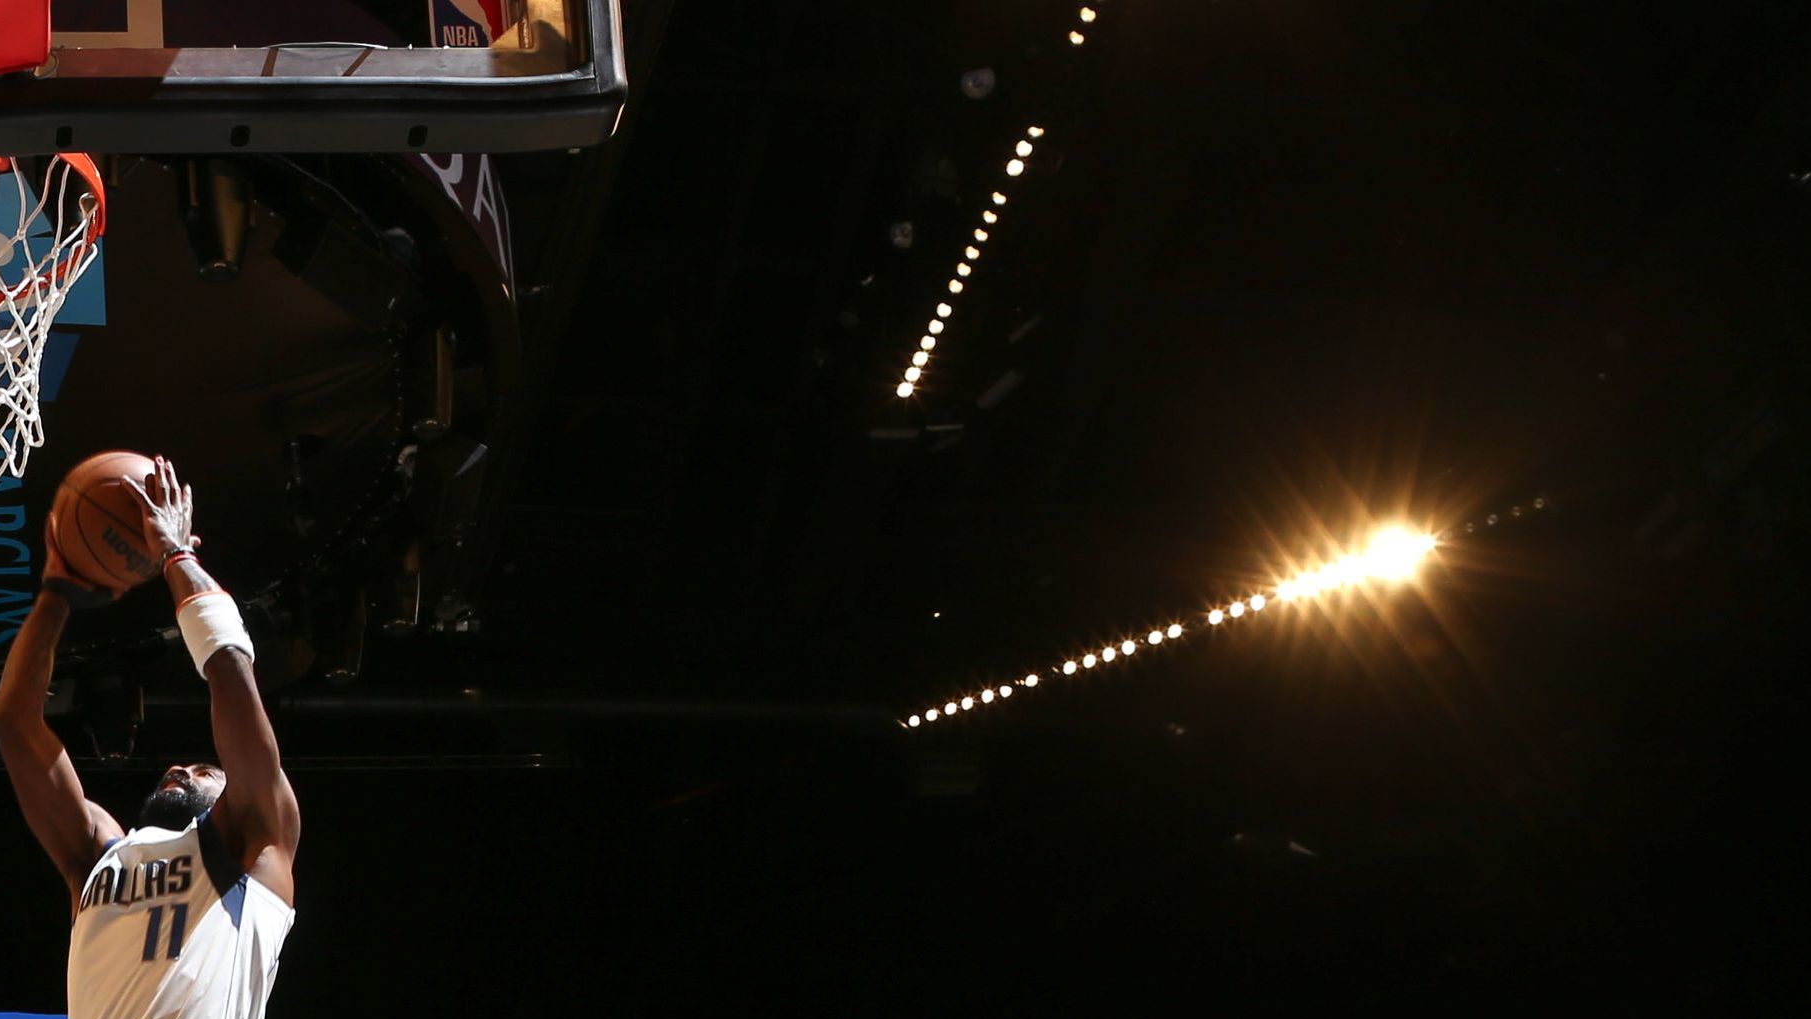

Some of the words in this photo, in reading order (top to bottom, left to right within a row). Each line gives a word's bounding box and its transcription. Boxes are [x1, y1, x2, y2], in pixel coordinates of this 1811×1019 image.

[443, 26, 479, 46] NBA
[79, 855, 192, 913] DALLAS
[141, 903, 188, 962] 11
